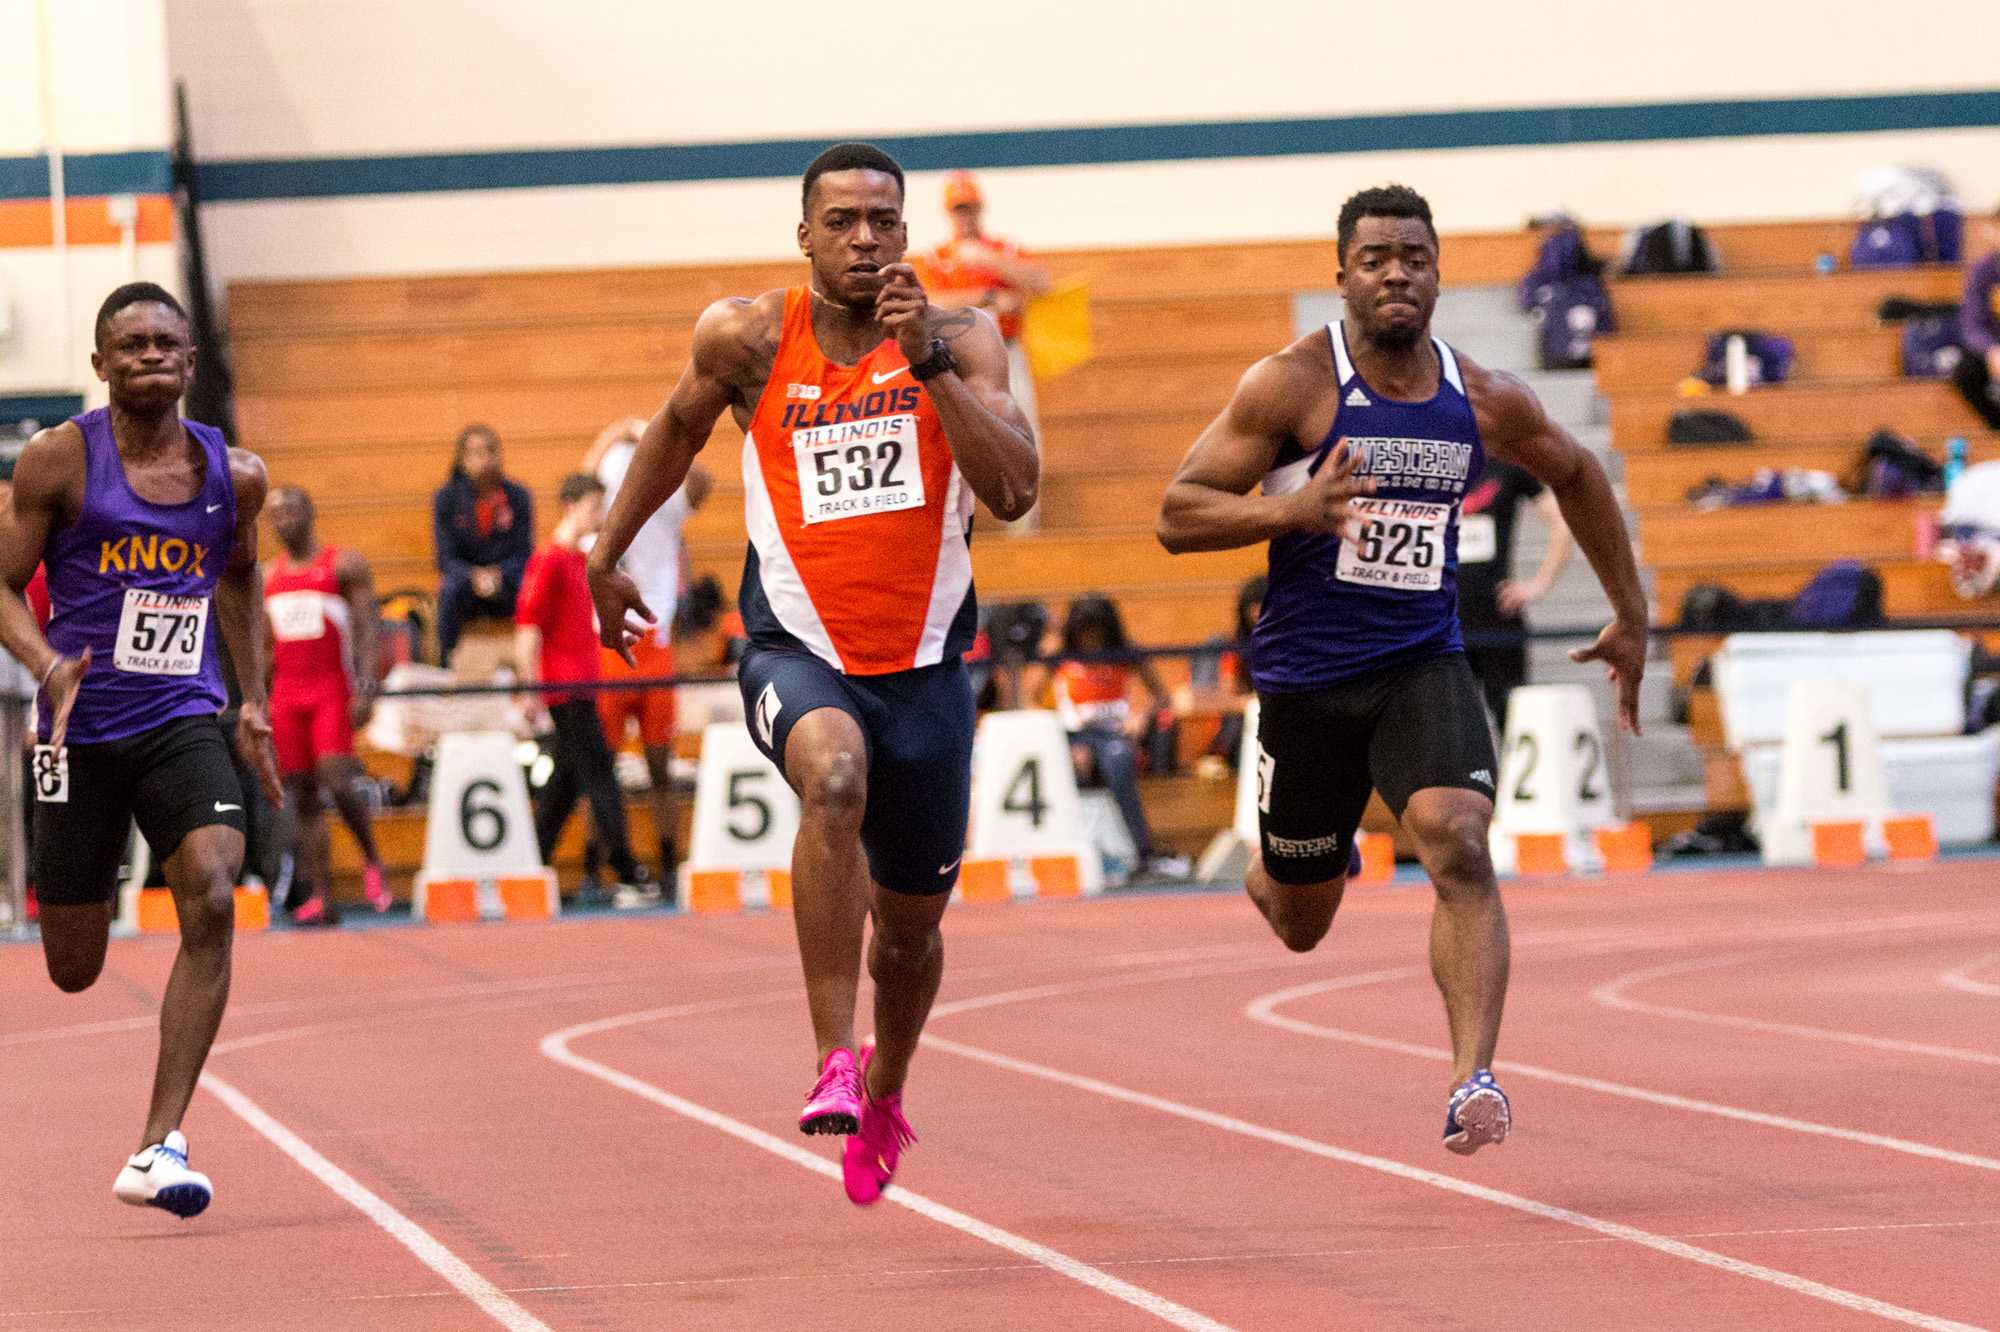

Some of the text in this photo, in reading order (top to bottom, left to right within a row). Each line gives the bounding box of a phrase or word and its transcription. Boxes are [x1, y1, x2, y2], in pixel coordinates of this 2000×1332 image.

[781, 385, 921, 428] ILLINOIS
[804, 418, 904, 448] ILLINOIS
[814, 440, 904, 497] 532
[1348, 437, 1472, 480] WESTERN
[819, 492, 909, 515] TRACK & FIELD
[1358, 501, 1441, 521] ILLINOIS
[99, 534, 209, 578] KNOX
[1357, 519, 1435, 568] 625
[1351, 566, 1430, 585] TRACK & FIELD
[134, 593, 203, 610] ILLINOIS
[131, 612, 199, 654] 573
[127, 656, 194, 670] TRACK & FIELD
[38, 750, 62, 797] 8
[1514, 733, 1540, 801] 2
[1574, 732, 1599, 801] 2
[1818, 720, 1850, 793] 1
[728, 771, 772, 841] 5
[1002, 758, 1048, 828] 4
[461, 779, 507, 851] 6
[1267, 832, 1337, 853] WESTERN
